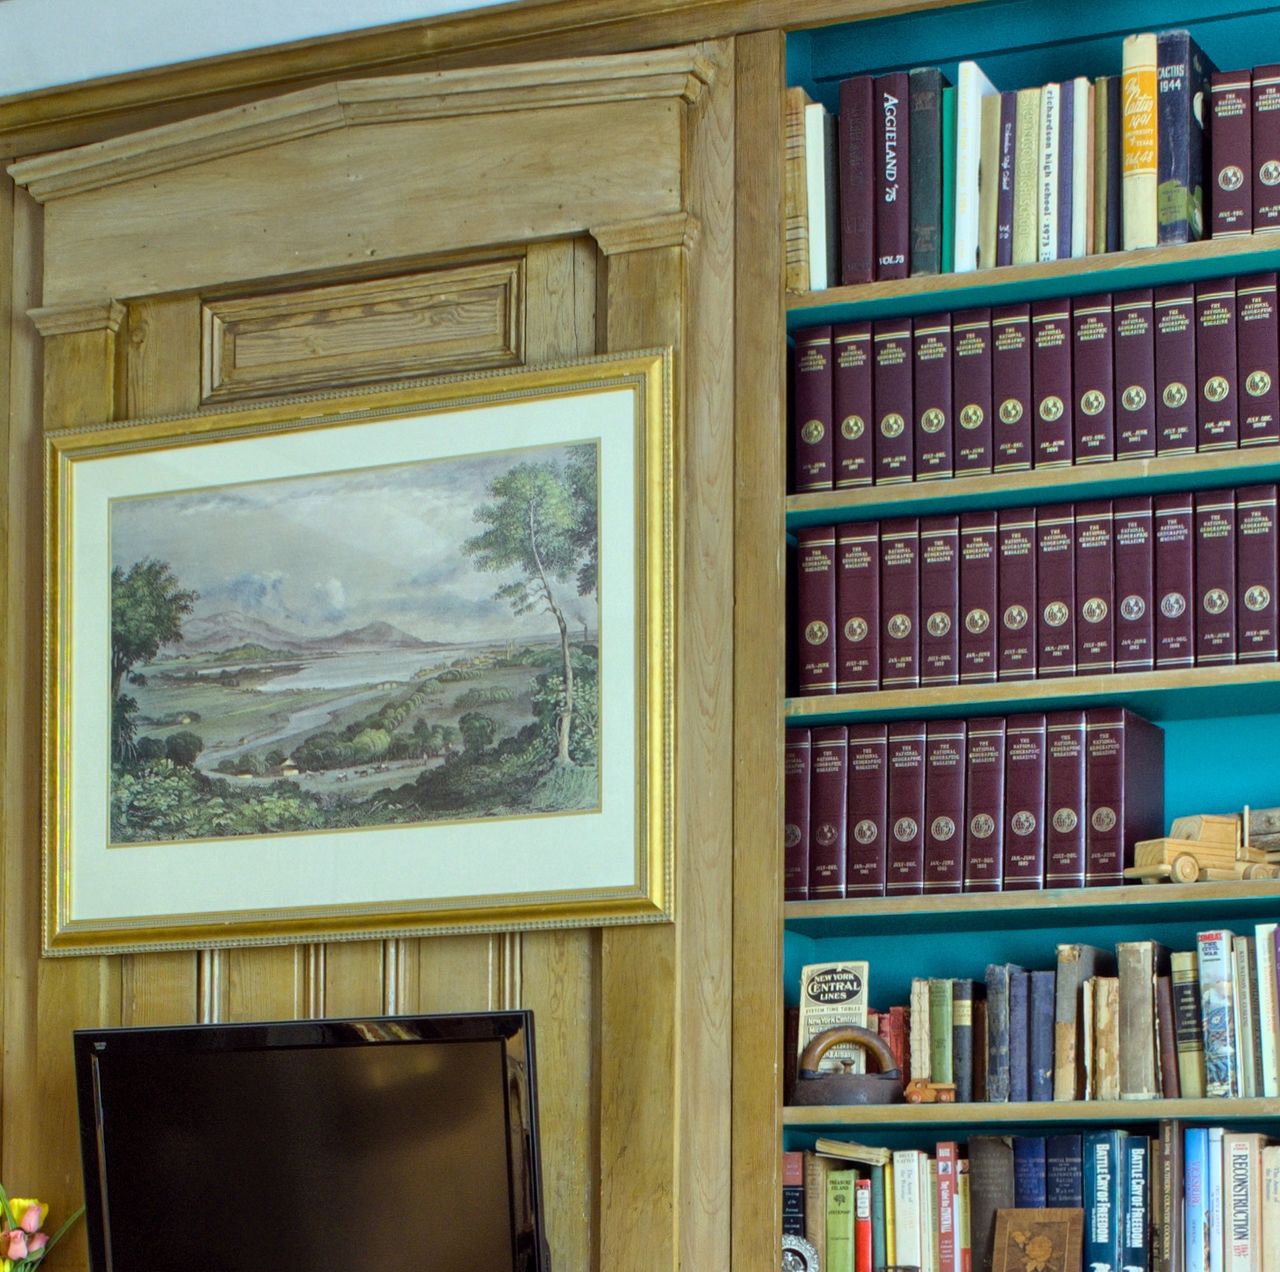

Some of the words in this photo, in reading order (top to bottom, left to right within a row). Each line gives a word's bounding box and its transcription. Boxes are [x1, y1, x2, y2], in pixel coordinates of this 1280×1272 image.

[1158, 64, 1185, 79] CACTUS
[1160, 79, 1182, 93] 1944
[1044, 90, 1054, 149] richardson
[884, 93, 899, 181] AGGIELAND
[1042, 154, 1053, 177] high
[1042, 182, 1052, 216] school
[1042, 224, 1051, 248] 1973
[808, 981, 860, 996] CENTRAL
[814, 974, 832, 983] NEW
[833, 973, 855, 982] YORK
[820, 993, 847, 1001] LINES
[1096, 1143, 1110, 1174] BATTLE
[1131, 1148, 1145, 1178] BATTLE
[1233, 1154, 1249, 1240] RECONSTRUCTION
[1096, 1202, 1111, 1243] FREEDOM
[1131, 1207, 1145, 1248] FREEDOM
